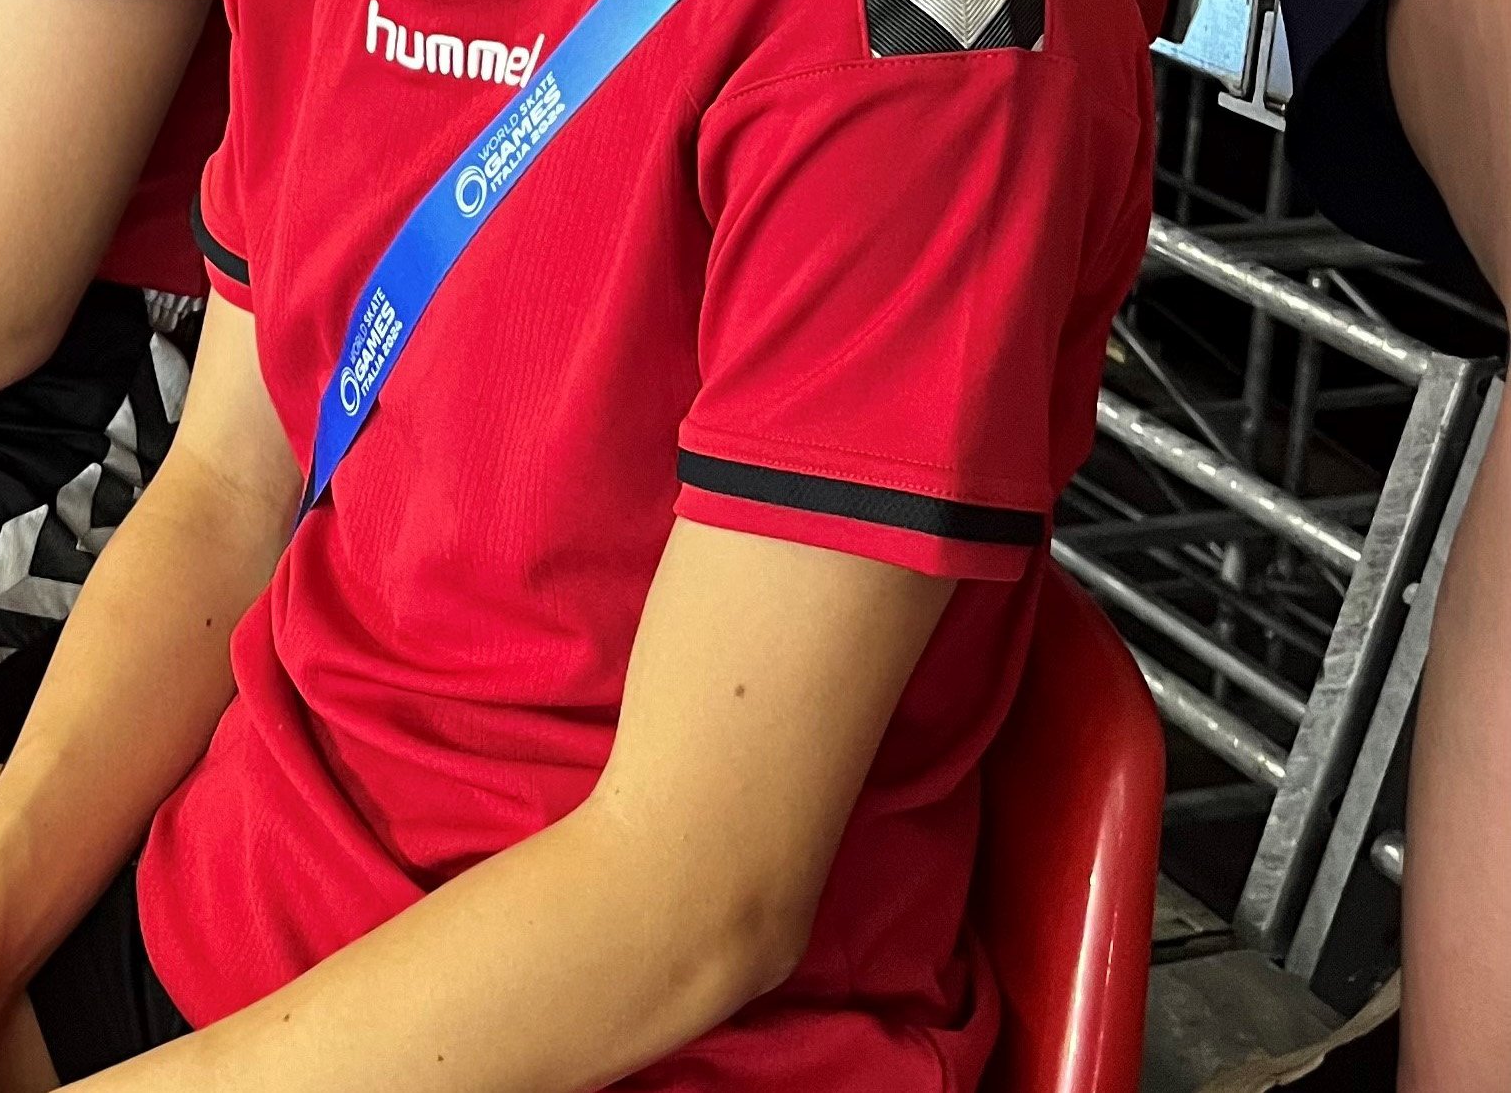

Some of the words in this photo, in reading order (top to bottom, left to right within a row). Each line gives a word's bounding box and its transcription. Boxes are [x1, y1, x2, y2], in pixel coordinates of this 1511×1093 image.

[477, 113, 519, 161] WORLD
[519, 70, 556, 116] SKATE
[483, 83, 561, 179] GAMES
[490, 143, 531, 192] ITALIA
[530, 103, 566, 146] 2024
[349, 323, 368, 365] WORLD
[363, 286, 386, 328] SKATE
[354, 300, 396, 382] GAMES
[360, 354, 386, 397] ITALIA
[381, 320, 403, 357] 2024
